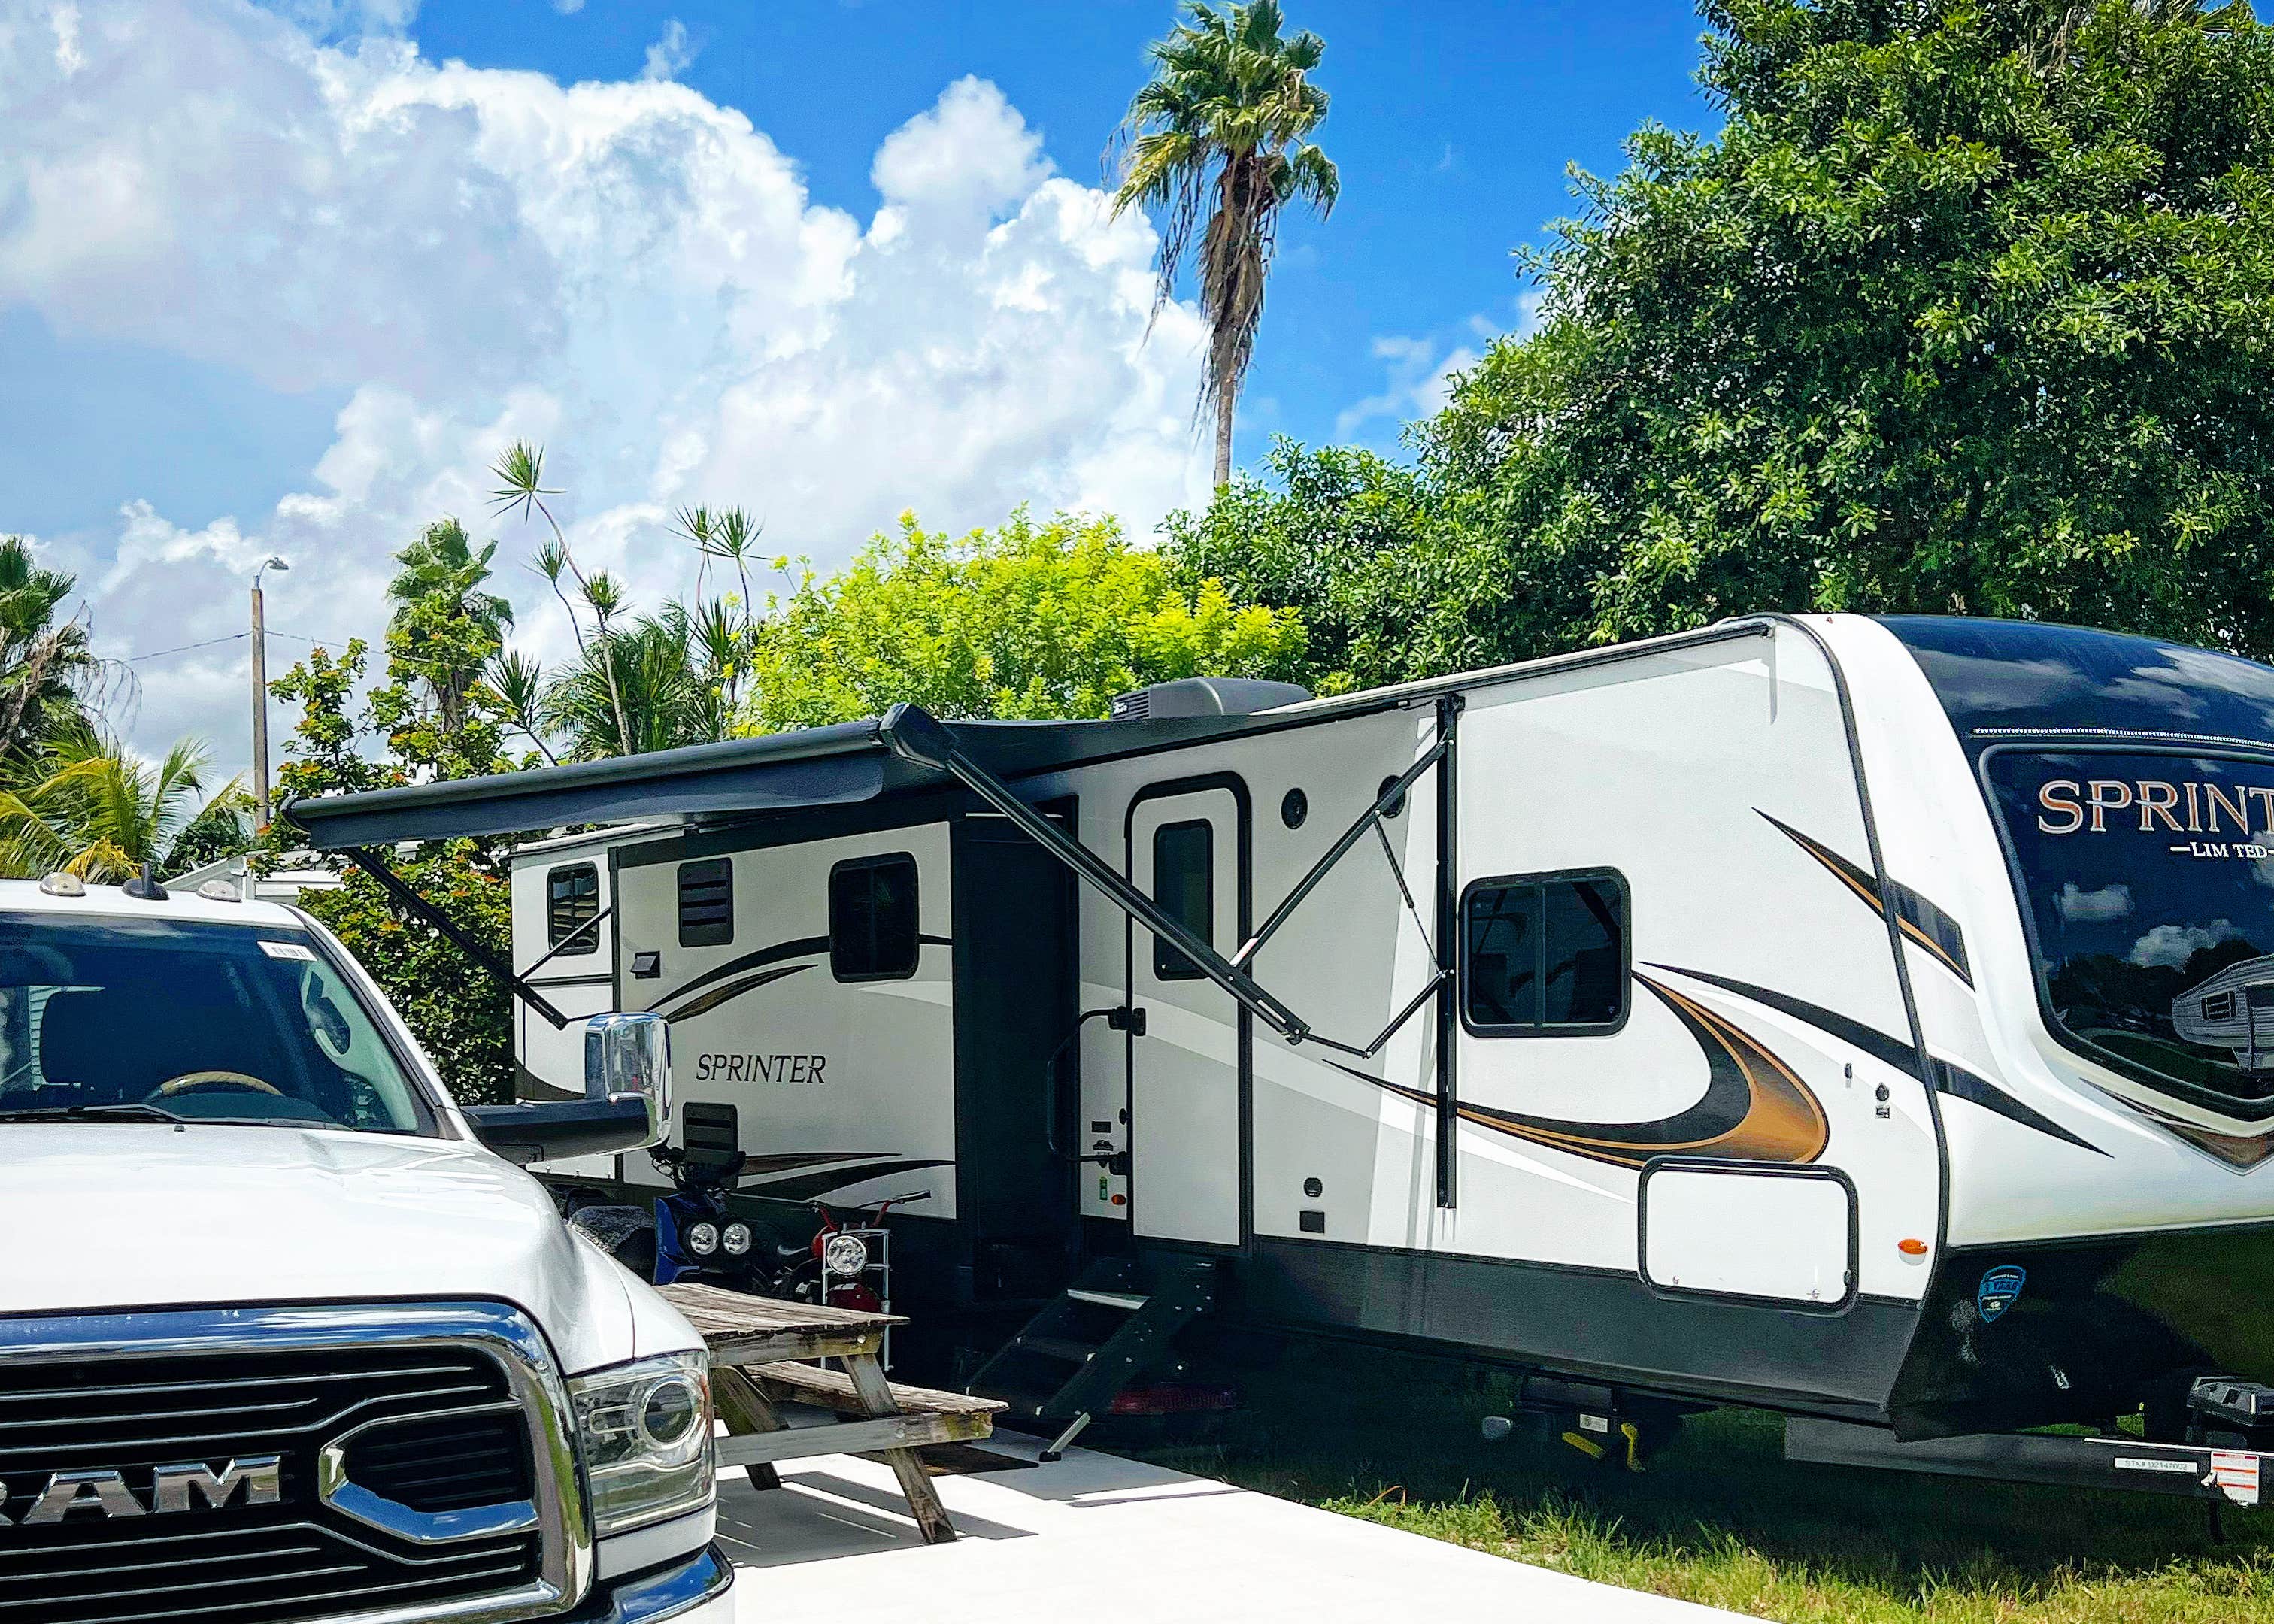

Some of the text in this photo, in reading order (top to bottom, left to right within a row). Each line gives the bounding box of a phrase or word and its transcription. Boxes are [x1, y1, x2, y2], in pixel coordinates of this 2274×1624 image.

[2189, 841, 2268, 858] LIMTED
[696, 1053, 826, 1083] SPRINTER
[0, 1455, 281, 1526] AM
